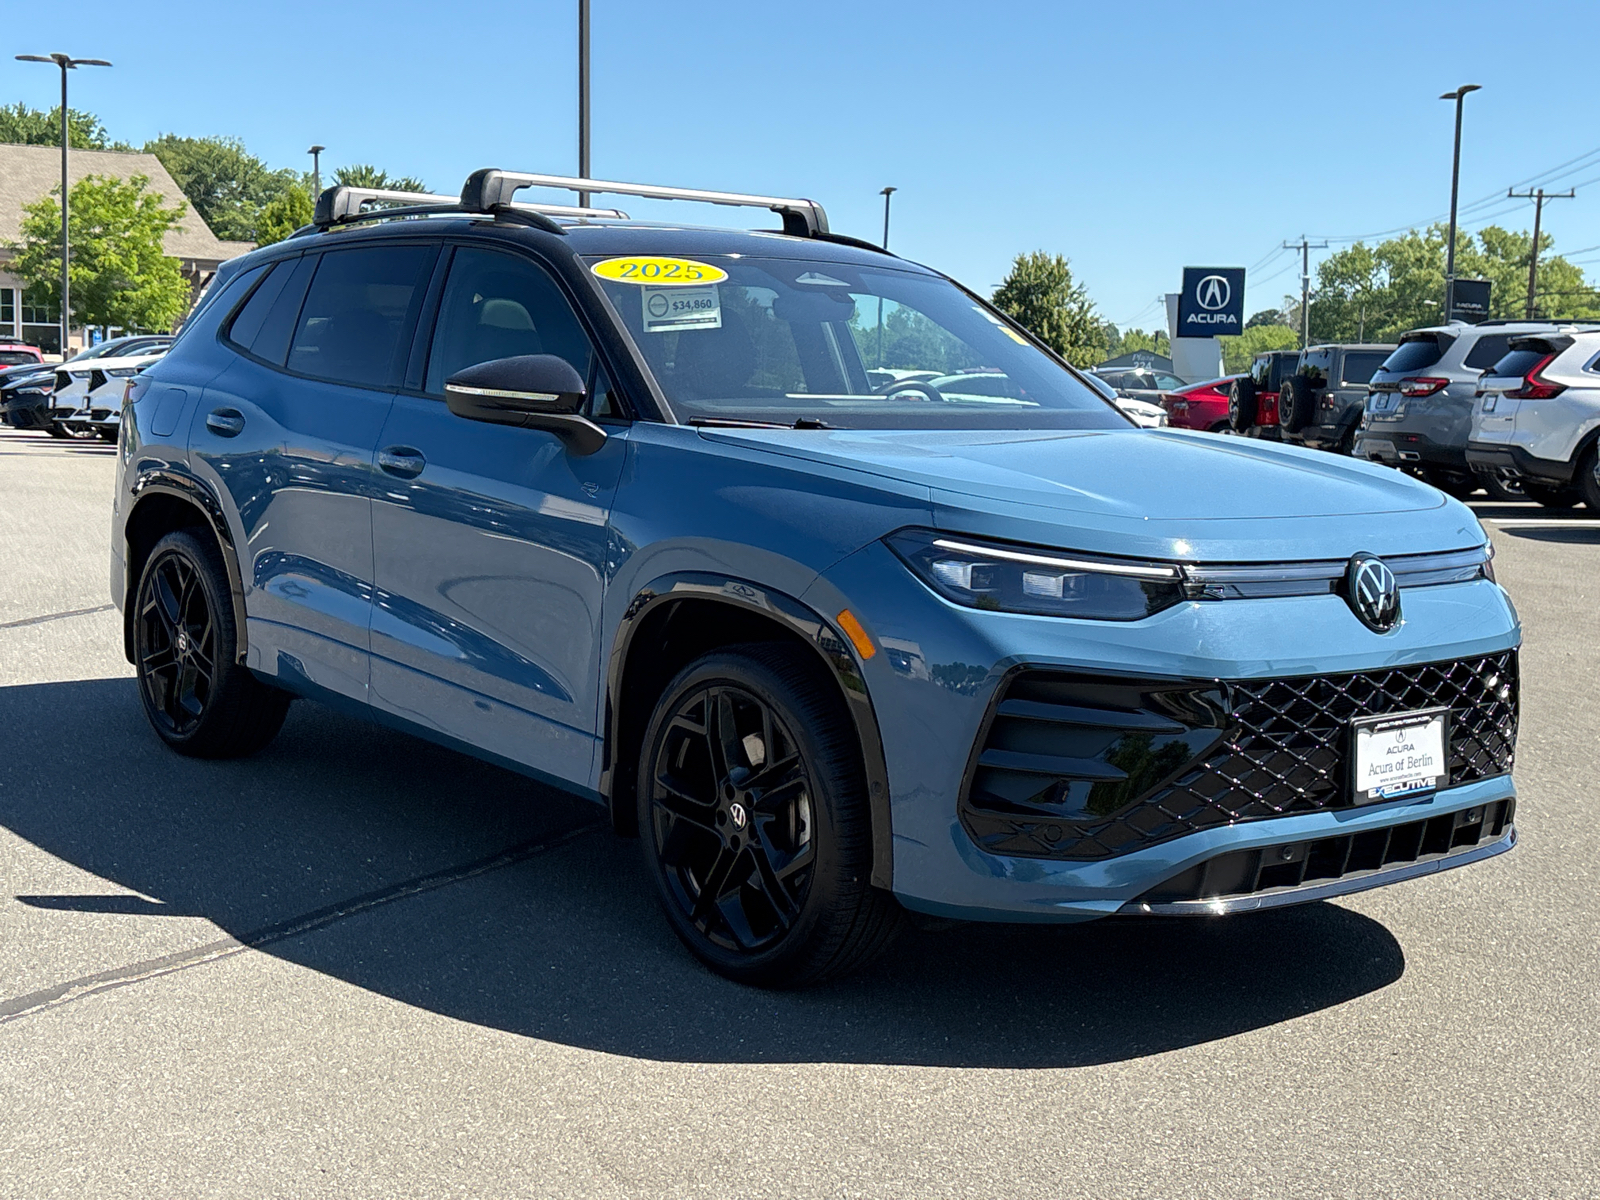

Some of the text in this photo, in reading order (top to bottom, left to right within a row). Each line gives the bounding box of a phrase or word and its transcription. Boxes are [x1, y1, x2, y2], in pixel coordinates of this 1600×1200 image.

[620, 262, 703, 280] 2025
[672, 299, 712, 313] $34,860
[1186, 313, 1238, 324] ACURA
[1386, 743, 1415, 755] ACURA
[1368, 753, 1433, 777] Acura of Berlin
